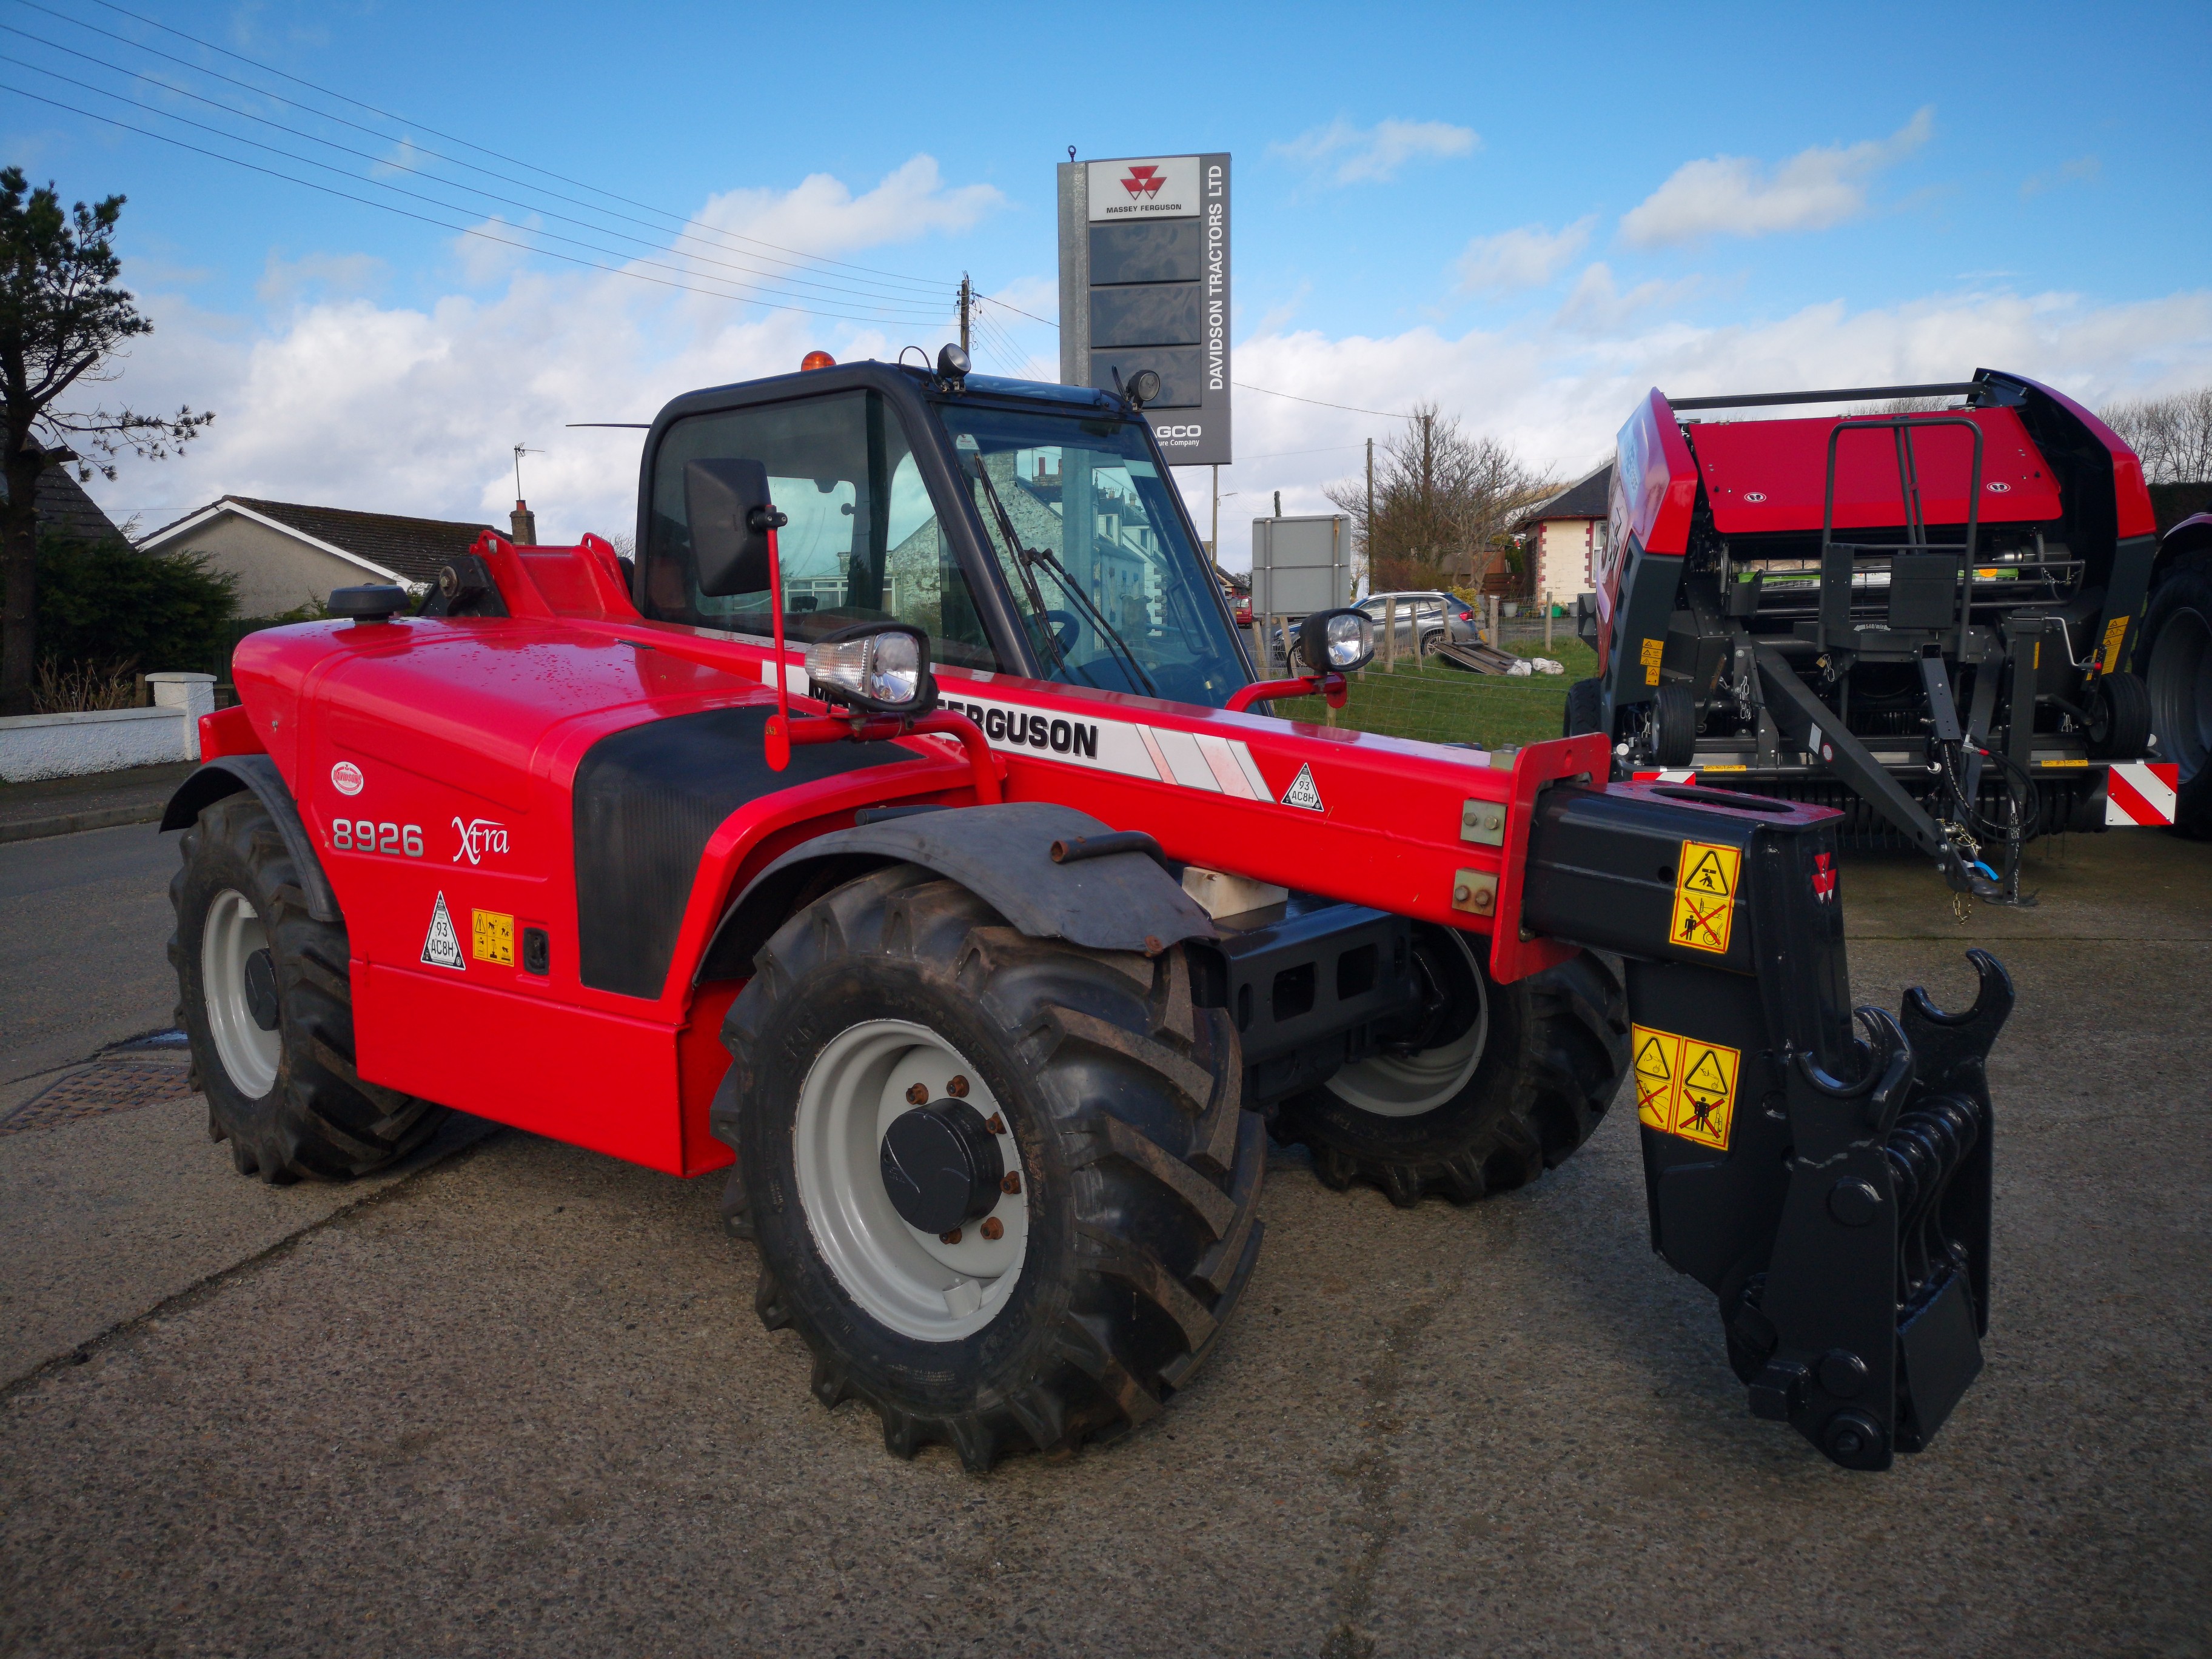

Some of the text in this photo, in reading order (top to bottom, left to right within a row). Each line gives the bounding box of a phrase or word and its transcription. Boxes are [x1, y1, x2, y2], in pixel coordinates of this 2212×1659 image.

[1208, 165, 1223, 390] DAVIDSON TRACTORS LTD
[1170, 439, 1200, 447] Company
[333, 769, 362, 785] DAVIDSONS
[1299, 780, 1310, 791] 93
[1292, 790, 1314, 803] AC8H
[332, 818, 424, 857] 8926
[451, 816, 510, 865] Xtra
[437, 921, 447, 937] 93
[431, 939, 454, 957] AC8H
